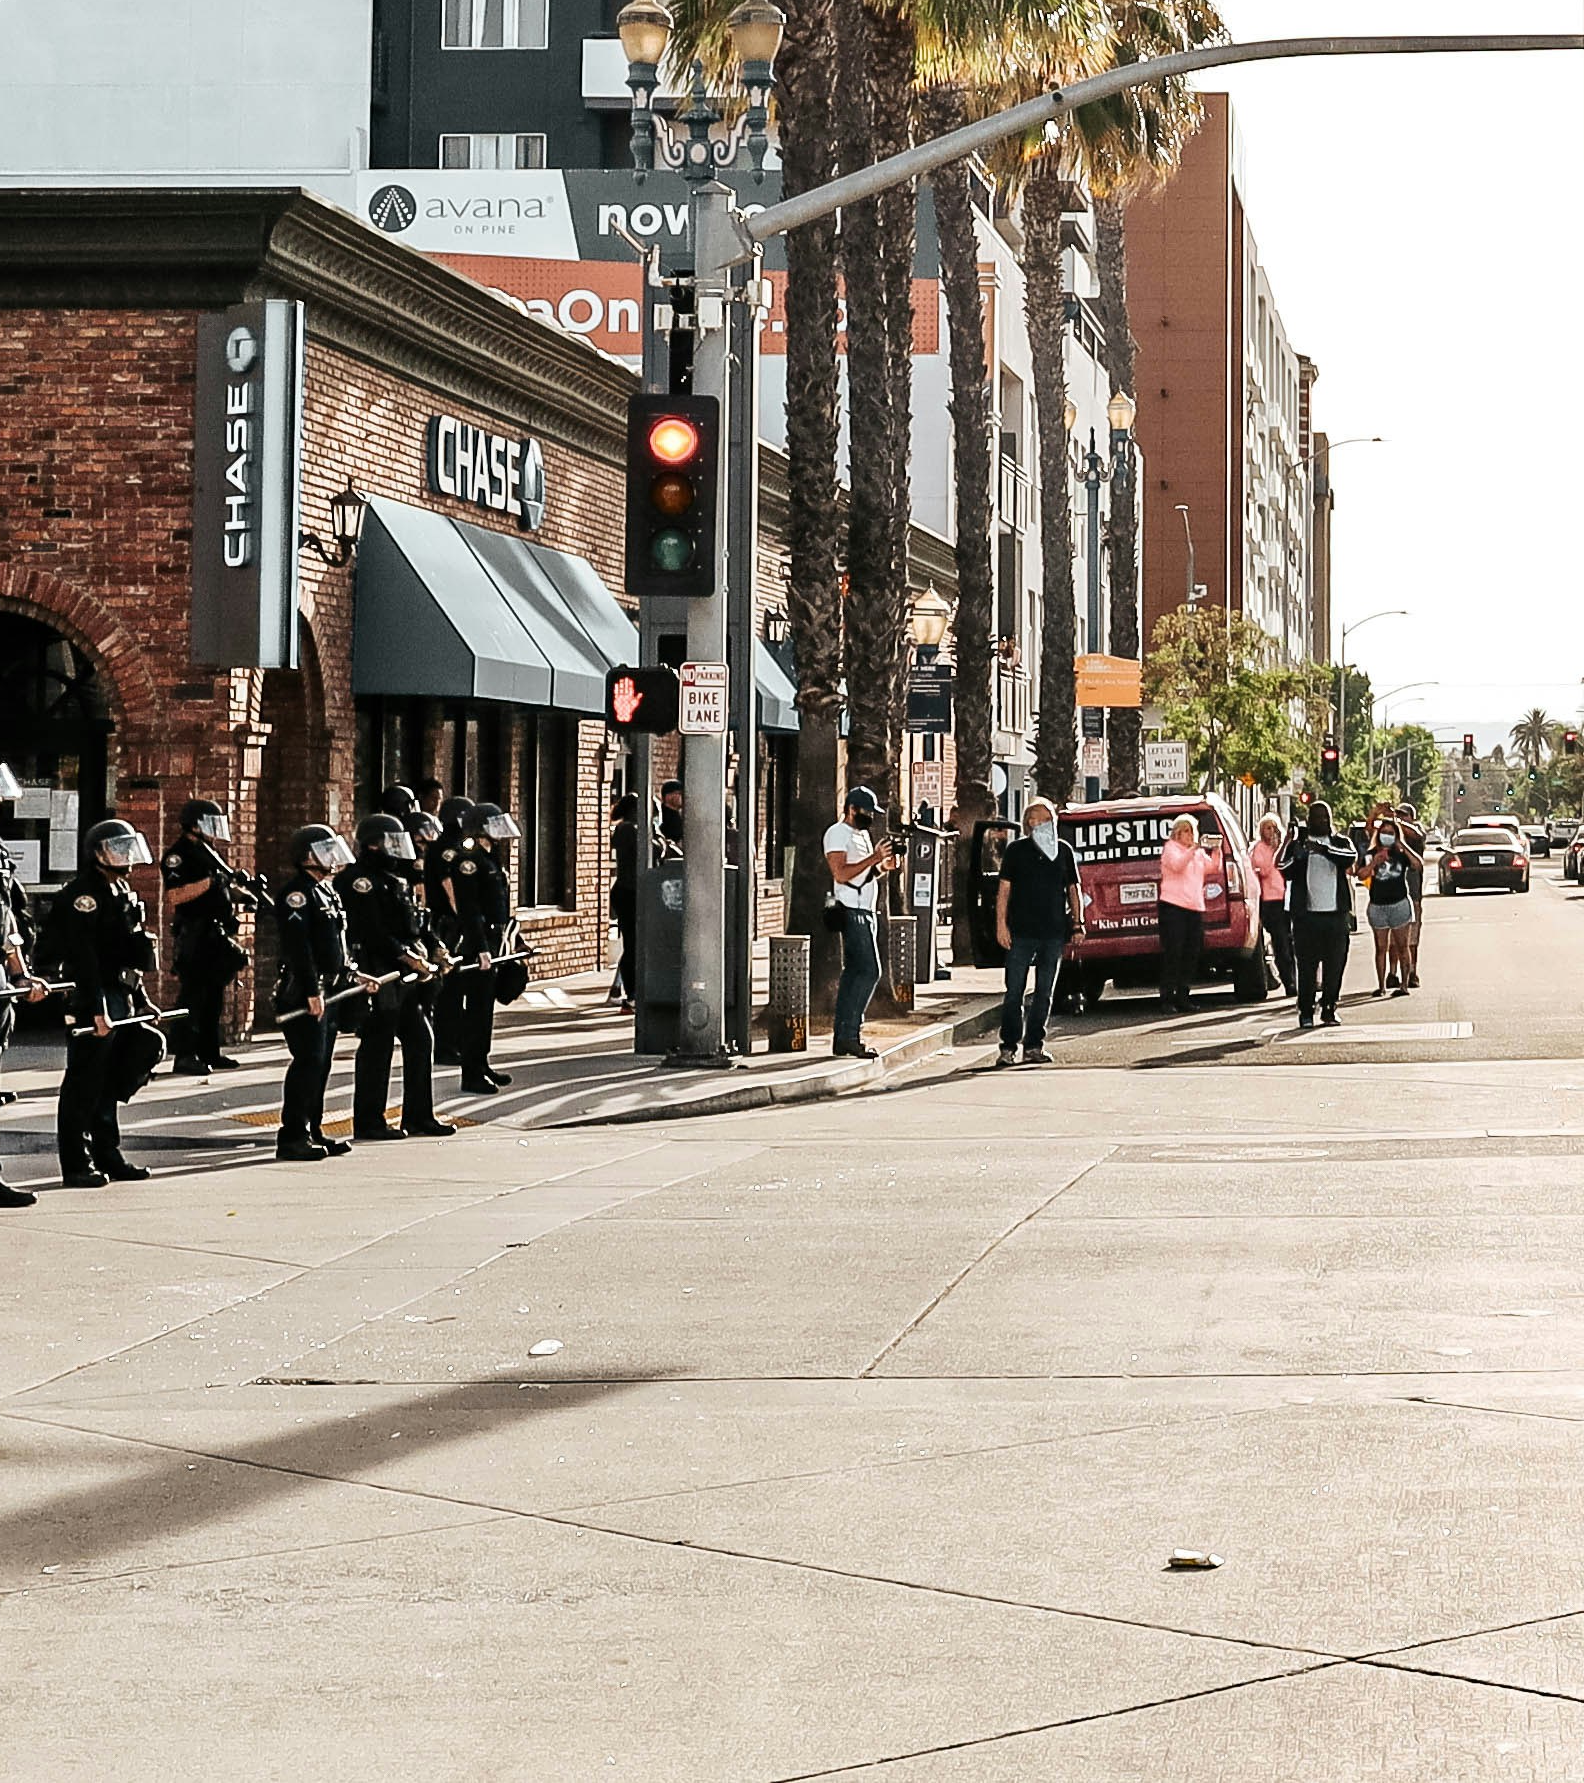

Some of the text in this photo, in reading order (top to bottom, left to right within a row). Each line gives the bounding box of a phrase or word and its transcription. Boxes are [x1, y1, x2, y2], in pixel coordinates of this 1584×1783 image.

[453, 225, 516, 235] ON PINE
[437, 414, 522, 516] CHASE
[224, 381, 249, 568] CHASE
[682, 668, 695, 683] NO
[688, 691, 719, 705] BIKE
[687, 709, 721, 723] LANE
[1154, 759, 1178, 768] MUST
[1075, 819, 1174, 848] LIPSTIC
[1083, 845, 1164, 862] Bail Bon
